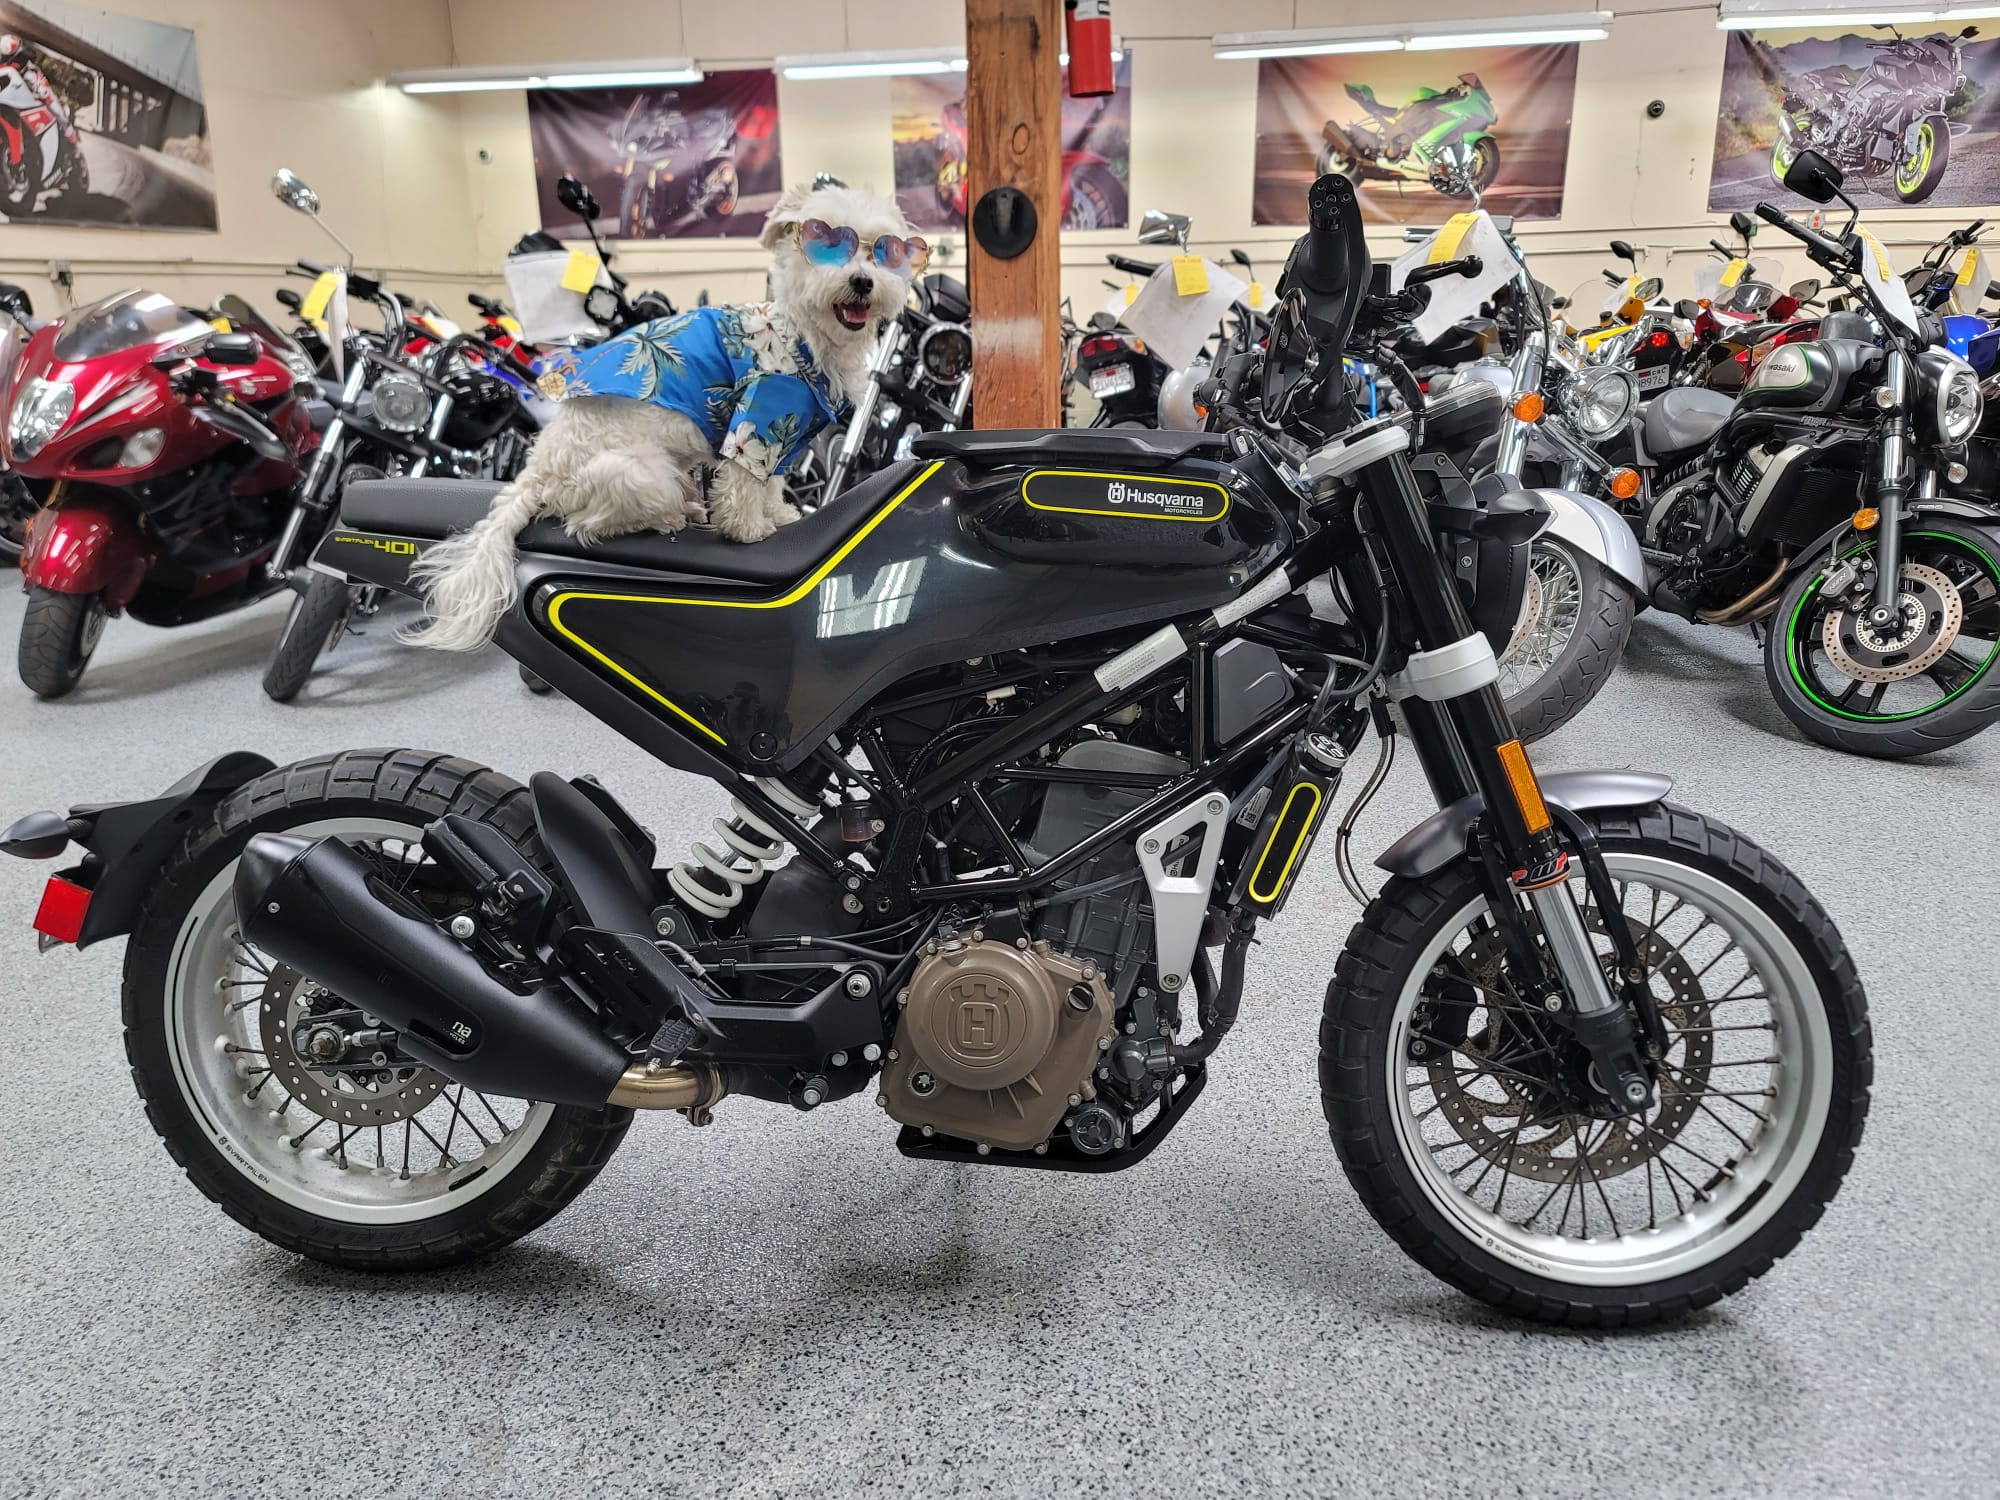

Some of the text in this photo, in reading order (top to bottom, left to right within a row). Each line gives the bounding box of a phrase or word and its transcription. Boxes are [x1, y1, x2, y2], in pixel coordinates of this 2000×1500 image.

[1126, 488, 1204, 507] Husqvarna
[1164, 507, 1203, 515] MOTORCYCLES
[374, 540, 415, 555] 401
[225, 1144, 270, 1184] SVARTPILEN
